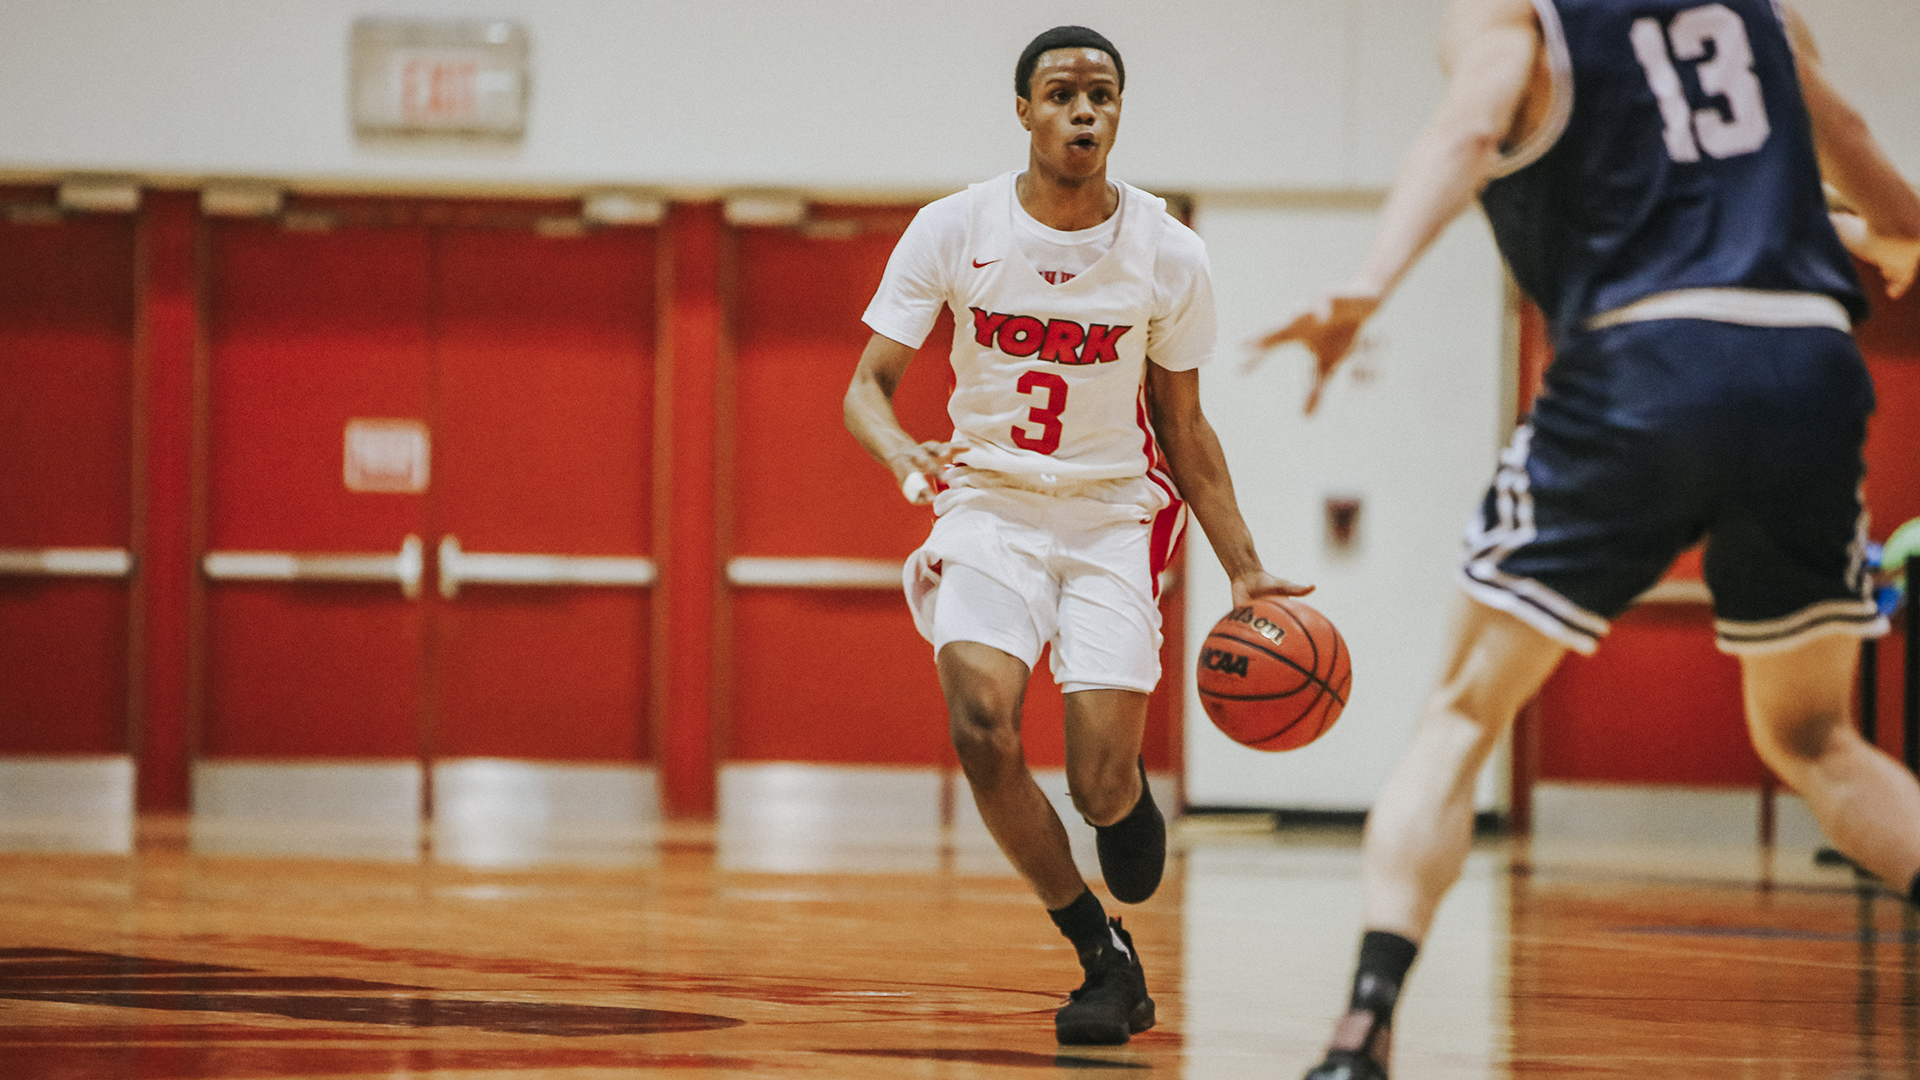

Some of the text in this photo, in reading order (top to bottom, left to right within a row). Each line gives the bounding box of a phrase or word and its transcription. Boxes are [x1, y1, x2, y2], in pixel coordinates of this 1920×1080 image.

[1629, 3, 1771, 163] 13
[968, 307, 1134, 366] YORK
[1010, 370, 1069, 456] 3
